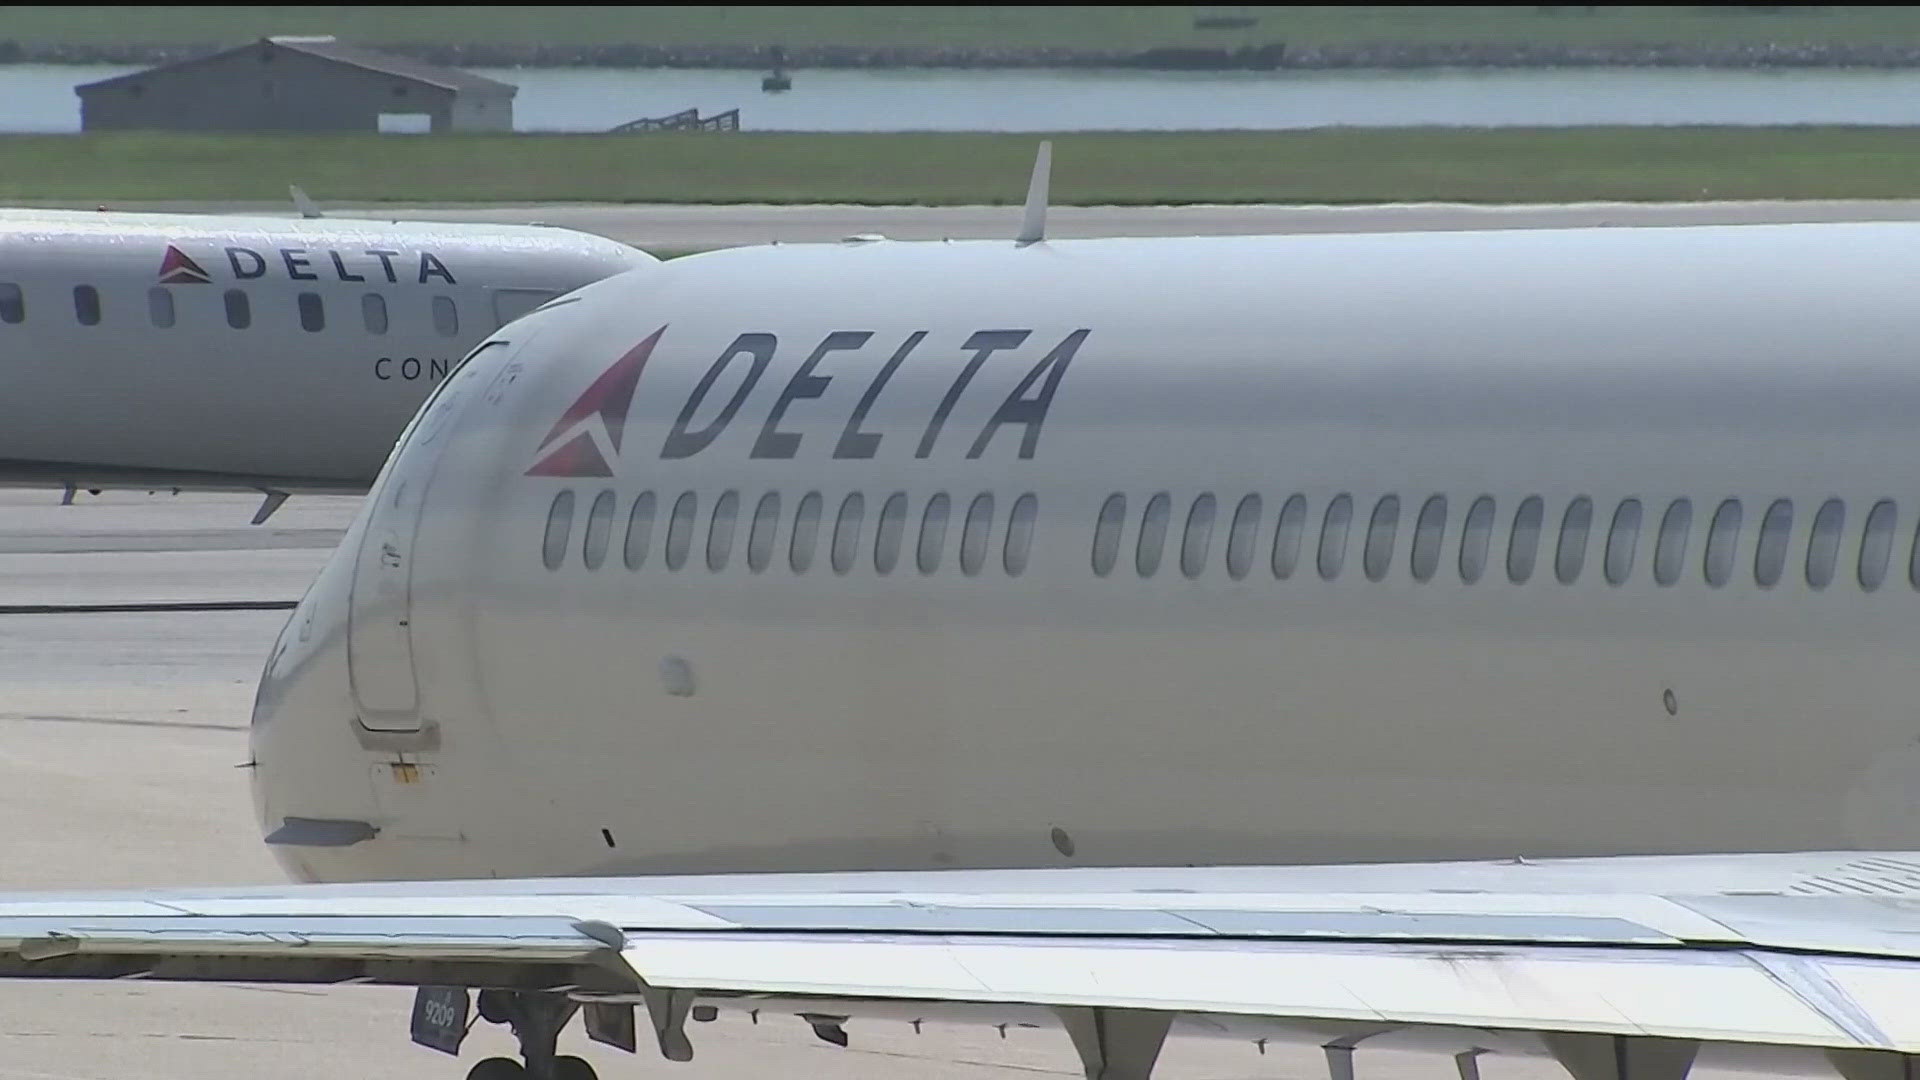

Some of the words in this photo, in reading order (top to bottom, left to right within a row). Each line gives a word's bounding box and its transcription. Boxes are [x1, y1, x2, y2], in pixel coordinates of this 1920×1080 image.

[224, 246, 457, 284] DELTA
[375, 357, 461, 380] CON
[659, 328, 1092, 460] DELTA
[425, 1000, 454, 1027] 9209
